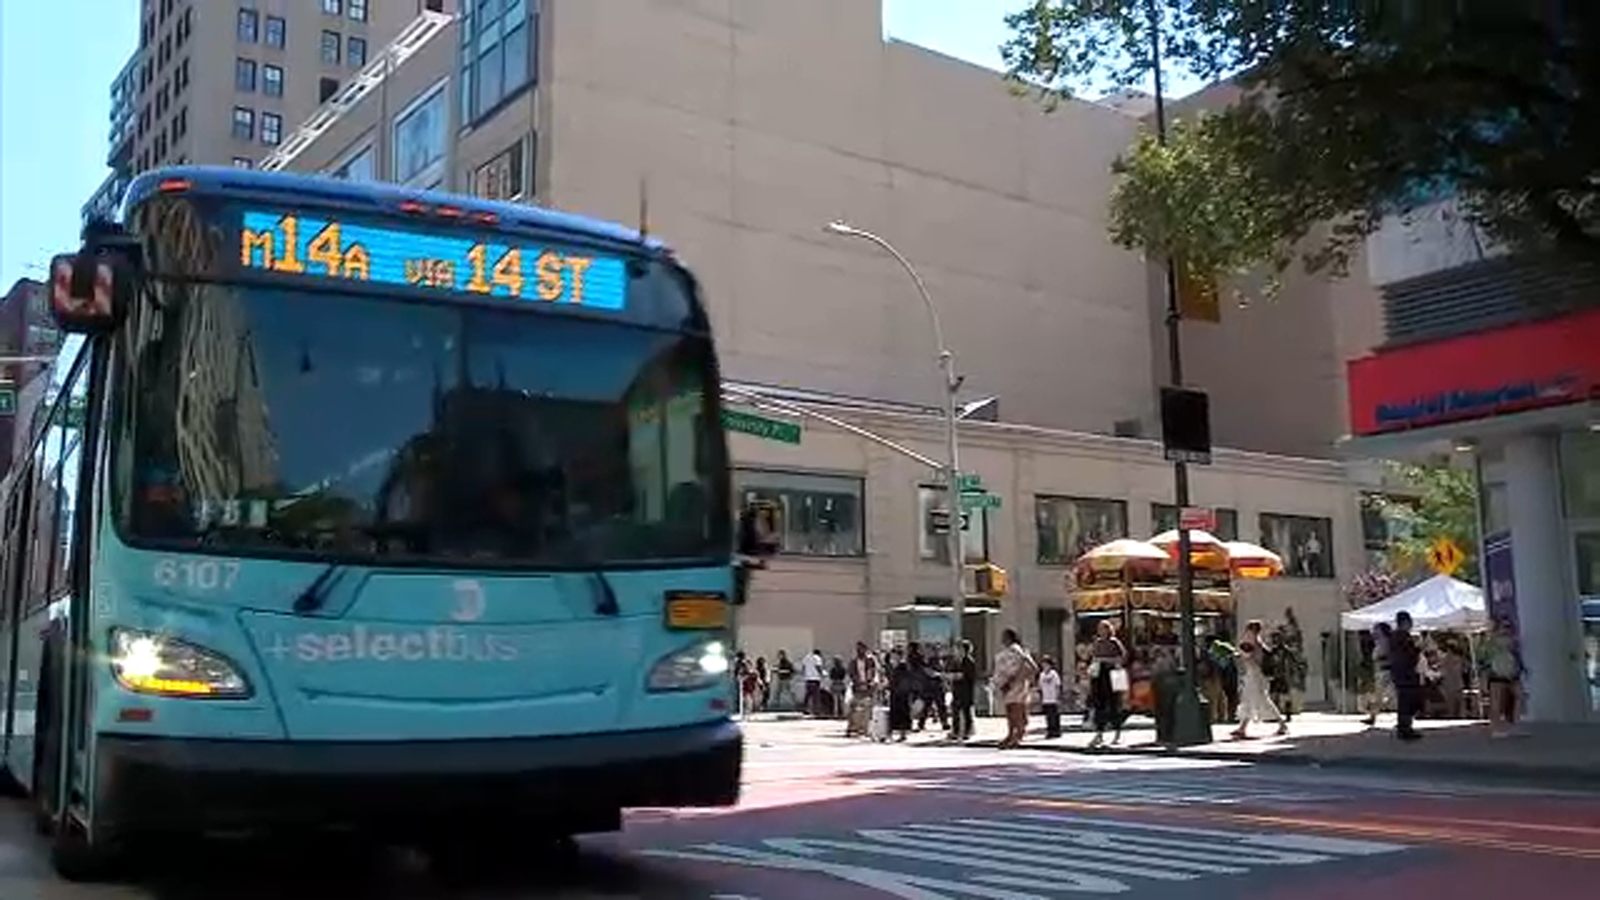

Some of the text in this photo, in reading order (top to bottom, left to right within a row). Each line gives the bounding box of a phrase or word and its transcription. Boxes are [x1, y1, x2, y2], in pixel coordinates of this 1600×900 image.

[465, 244, 522, 296] 14
[537, 250, 592, 304] ST
[154, 558, 240, 590] 6107
